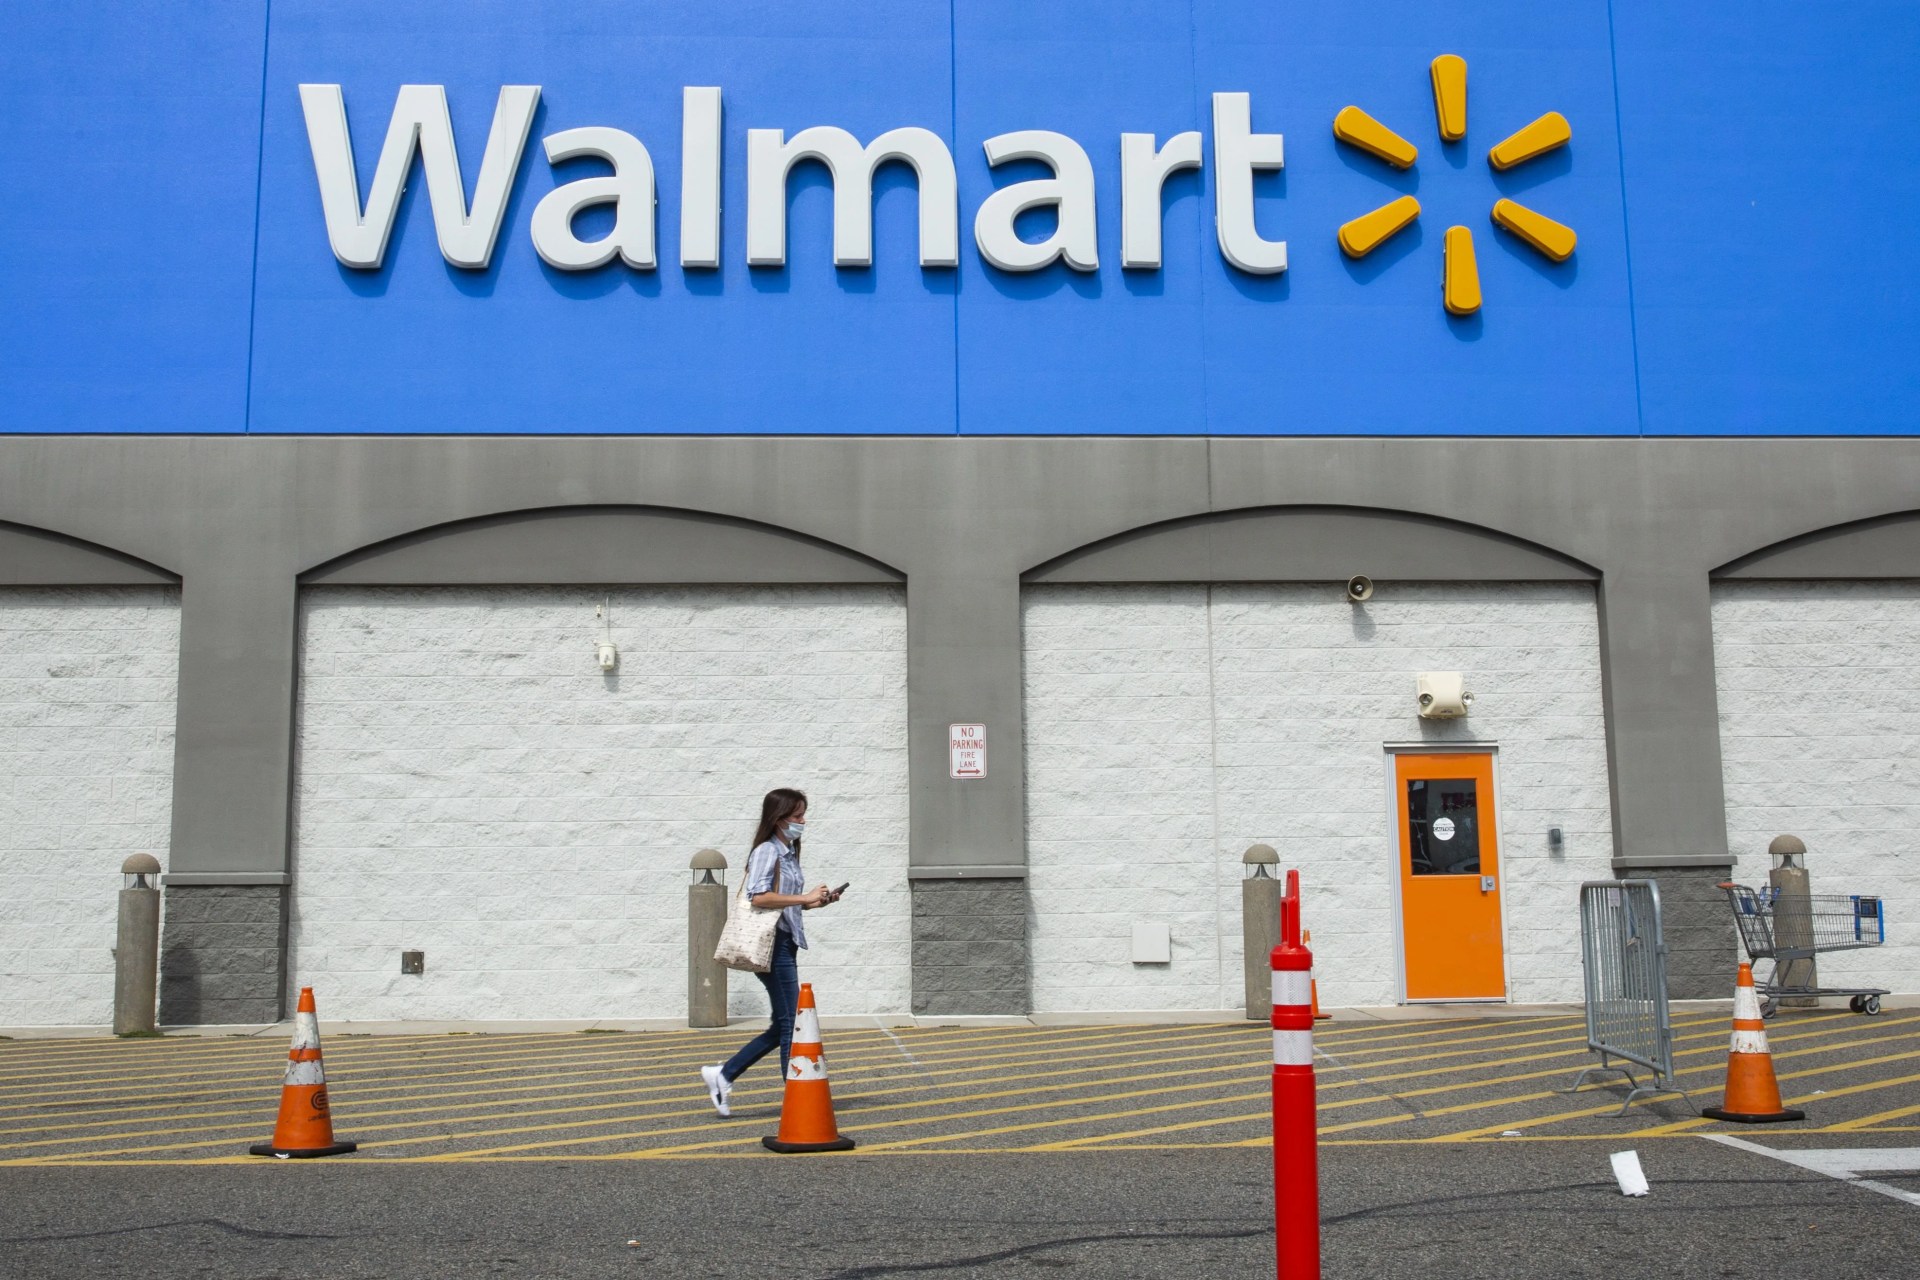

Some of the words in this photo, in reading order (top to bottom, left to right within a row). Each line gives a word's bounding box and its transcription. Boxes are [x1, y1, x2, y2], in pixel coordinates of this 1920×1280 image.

[298, 83, 1288, 275] Walmart
[961, 727, 975, 738] NO
[952, 739, 984, 750] PARKING
[960, 751, 976, 759] FIRE
[959, 760, 977, 768] LANE
